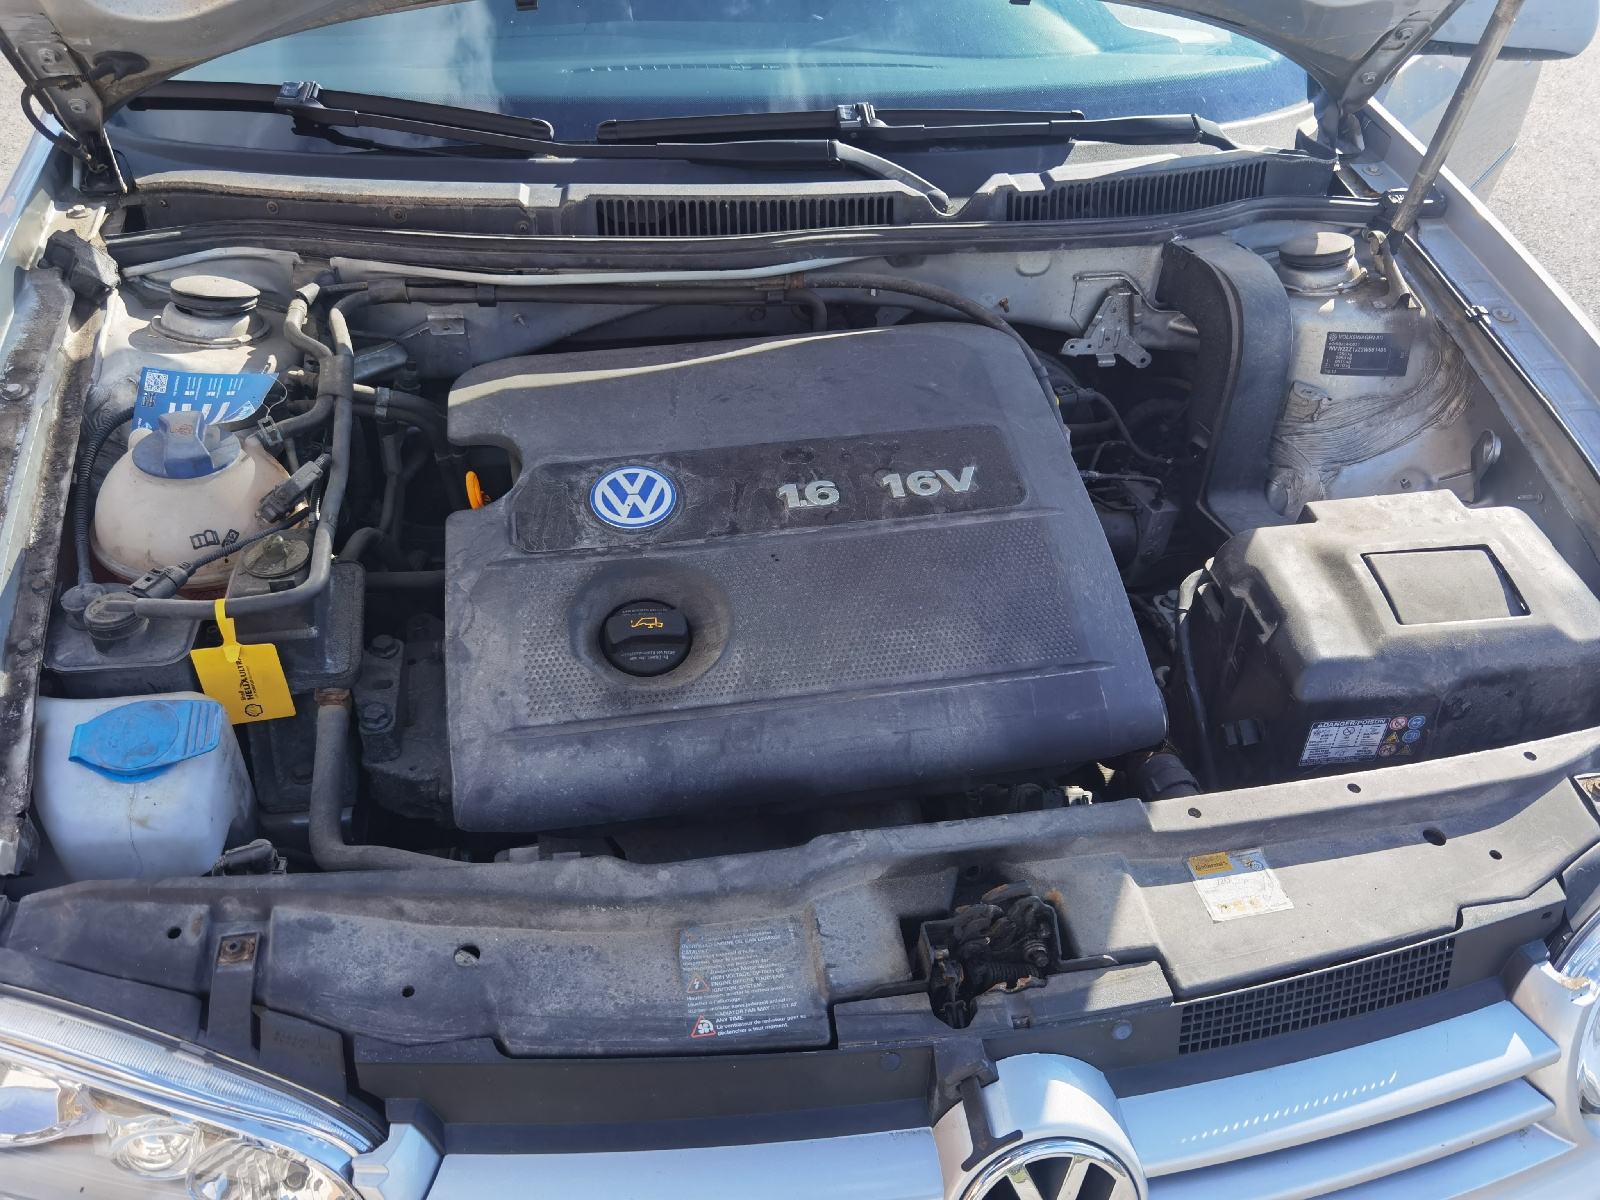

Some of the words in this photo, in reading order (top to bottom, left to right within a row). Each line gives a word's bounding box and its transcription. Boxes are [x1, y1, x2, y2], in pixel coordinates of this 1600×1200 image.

[590, 465, 677, 529] VW
[882, 466, 976, 499] 16V
[241, 680, 254, 700] HELIX
